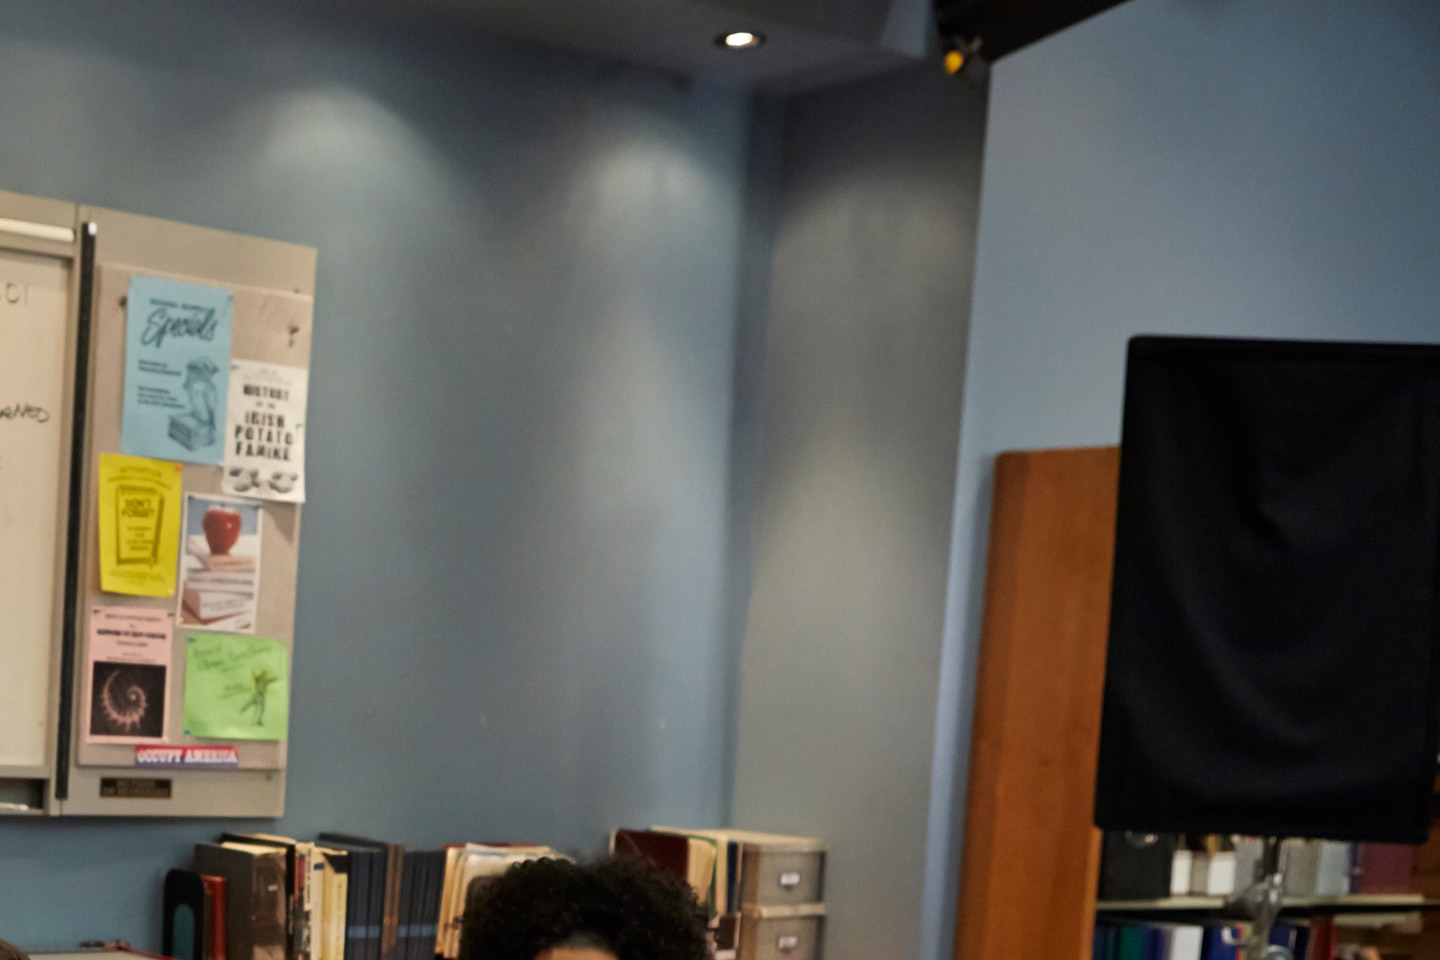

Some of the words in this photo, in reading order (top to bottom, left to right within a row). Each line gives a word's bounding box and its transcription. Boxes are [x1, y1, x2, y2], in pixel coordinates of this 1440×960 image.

[245, 410, 285, 428] IRISH
[235, 425, 293, 446] POTATO
[235, 442, 291, 461] FAMINE
[184, 748, 239, 764] AMERICA
